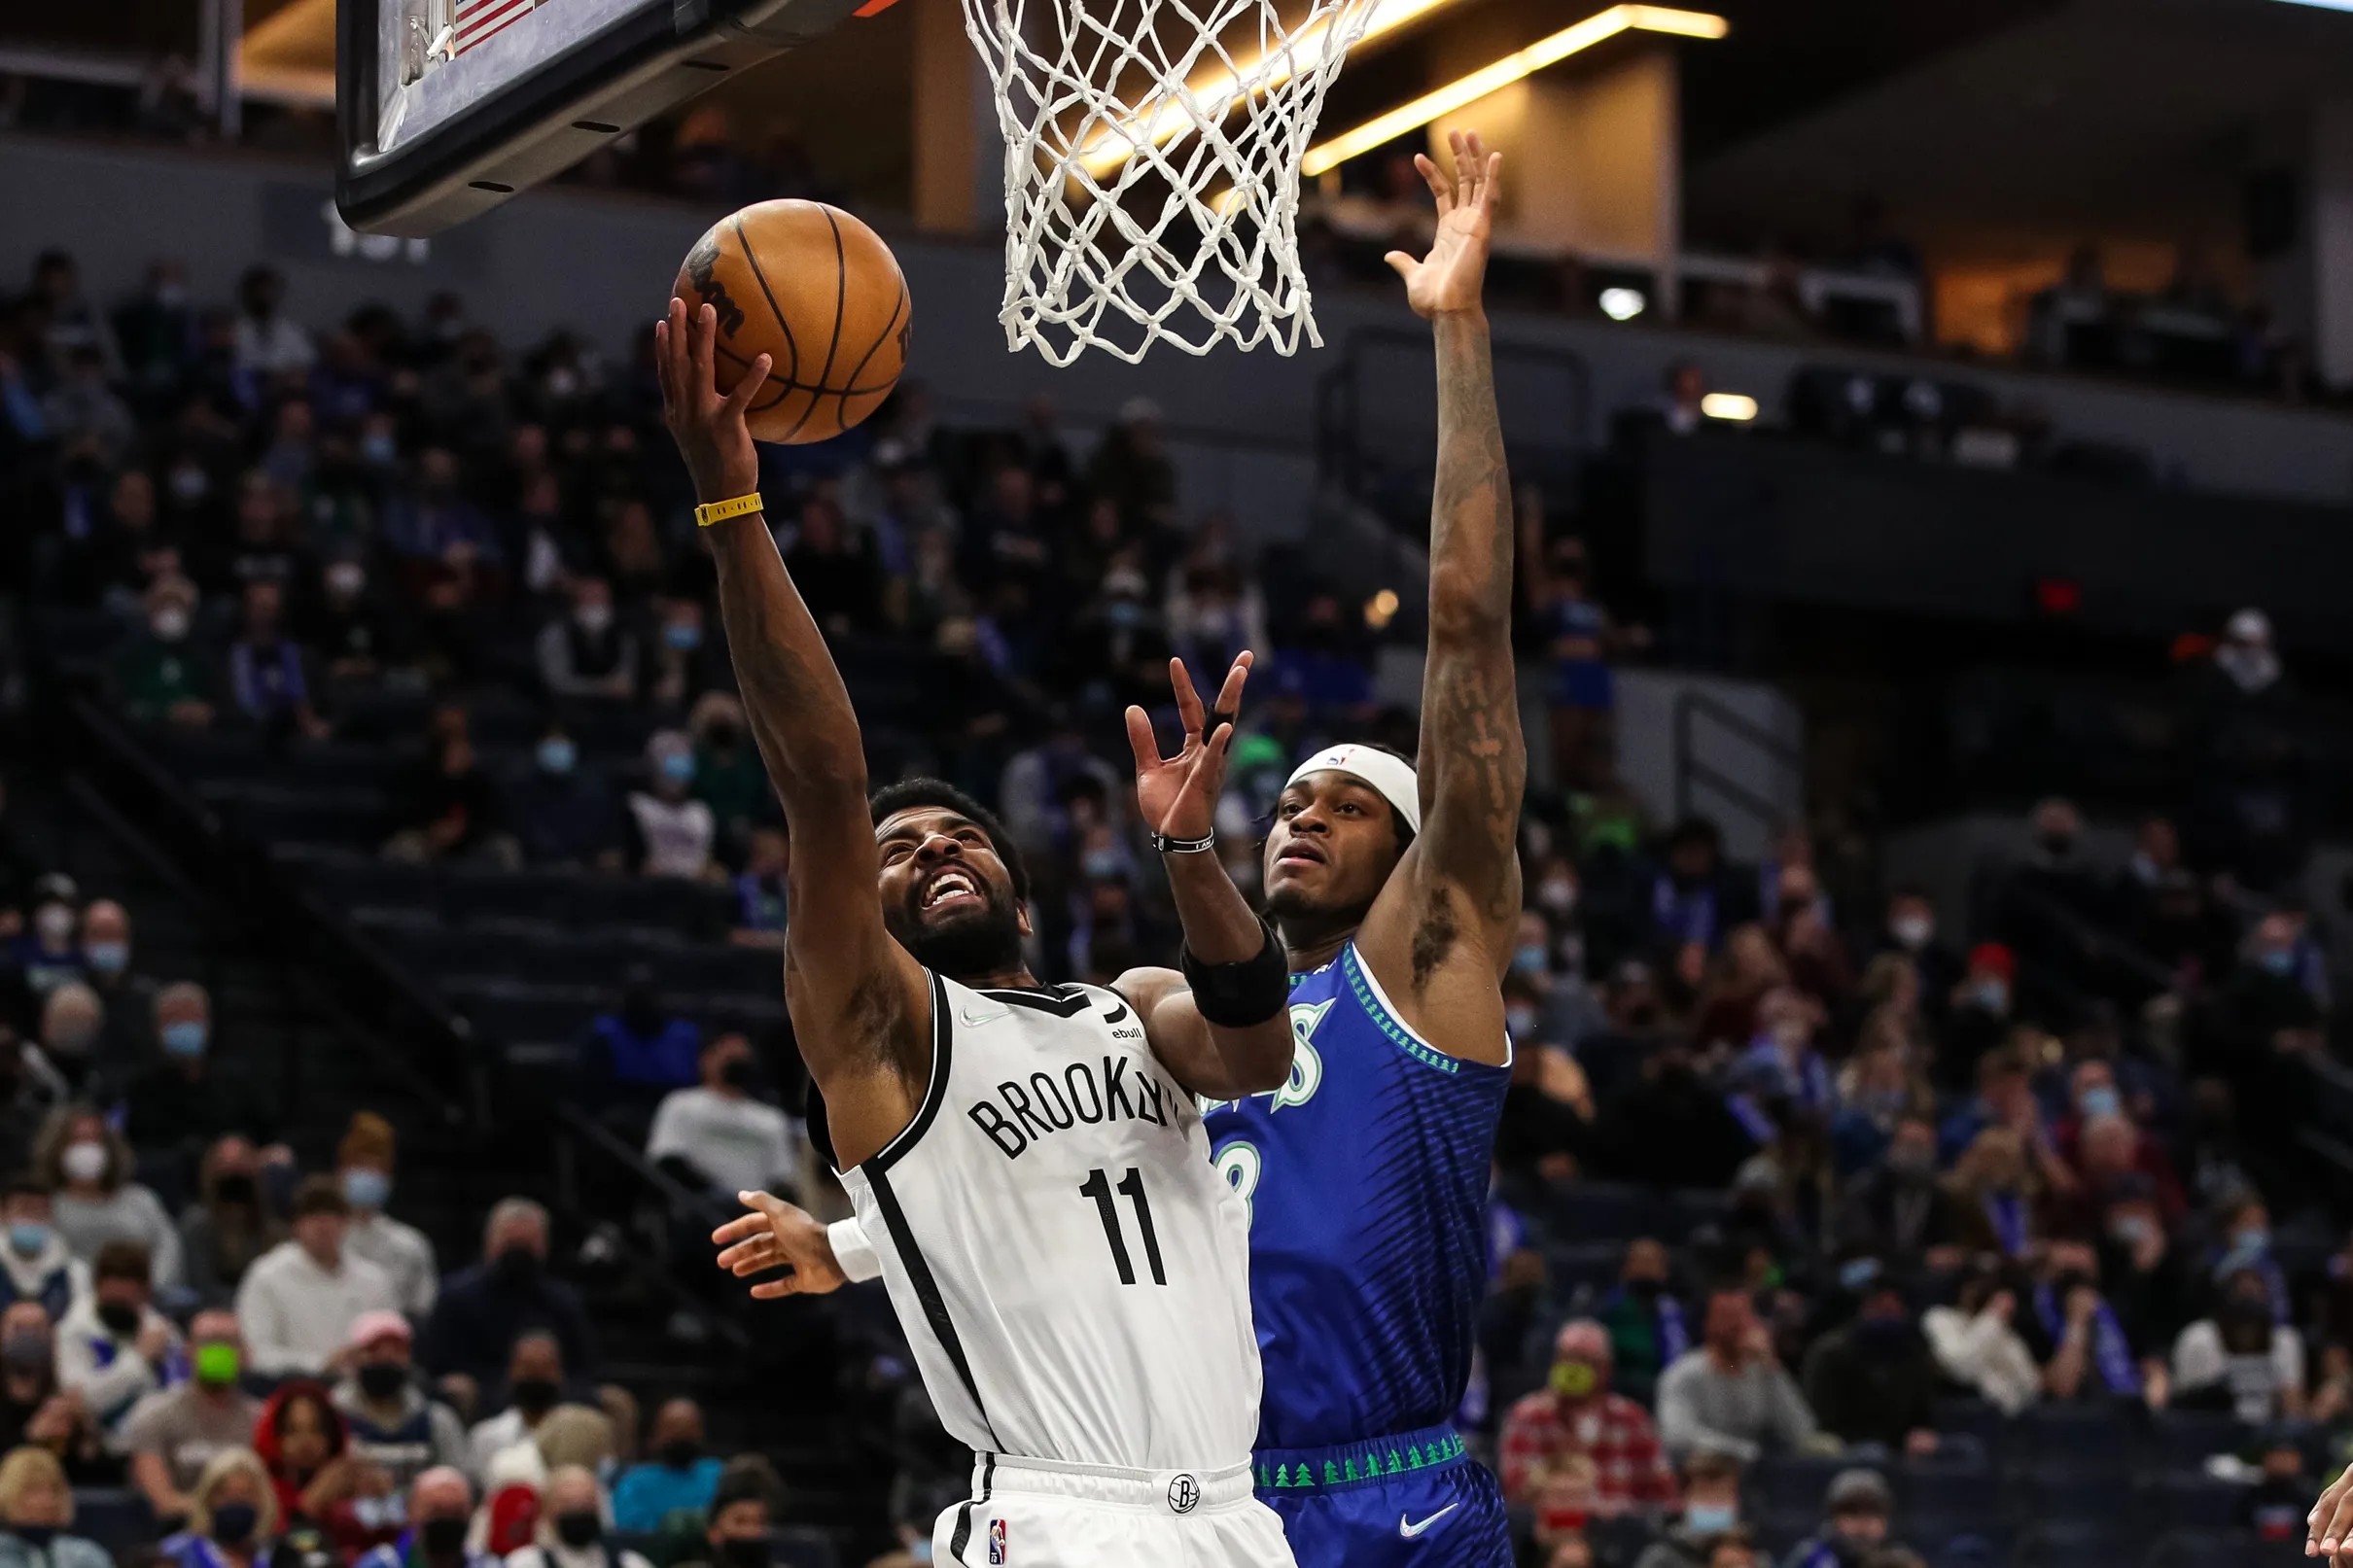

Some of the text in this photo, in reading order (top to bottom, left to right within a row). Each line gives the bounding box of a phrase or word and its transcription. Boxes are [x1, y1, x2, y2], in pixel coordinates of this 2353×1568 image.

[1111, 1028, 1142, 1038] ebull
[967, 1056, 1187, 1160] BROOKLY
[1079, 1167, 1167, 1285] 11
